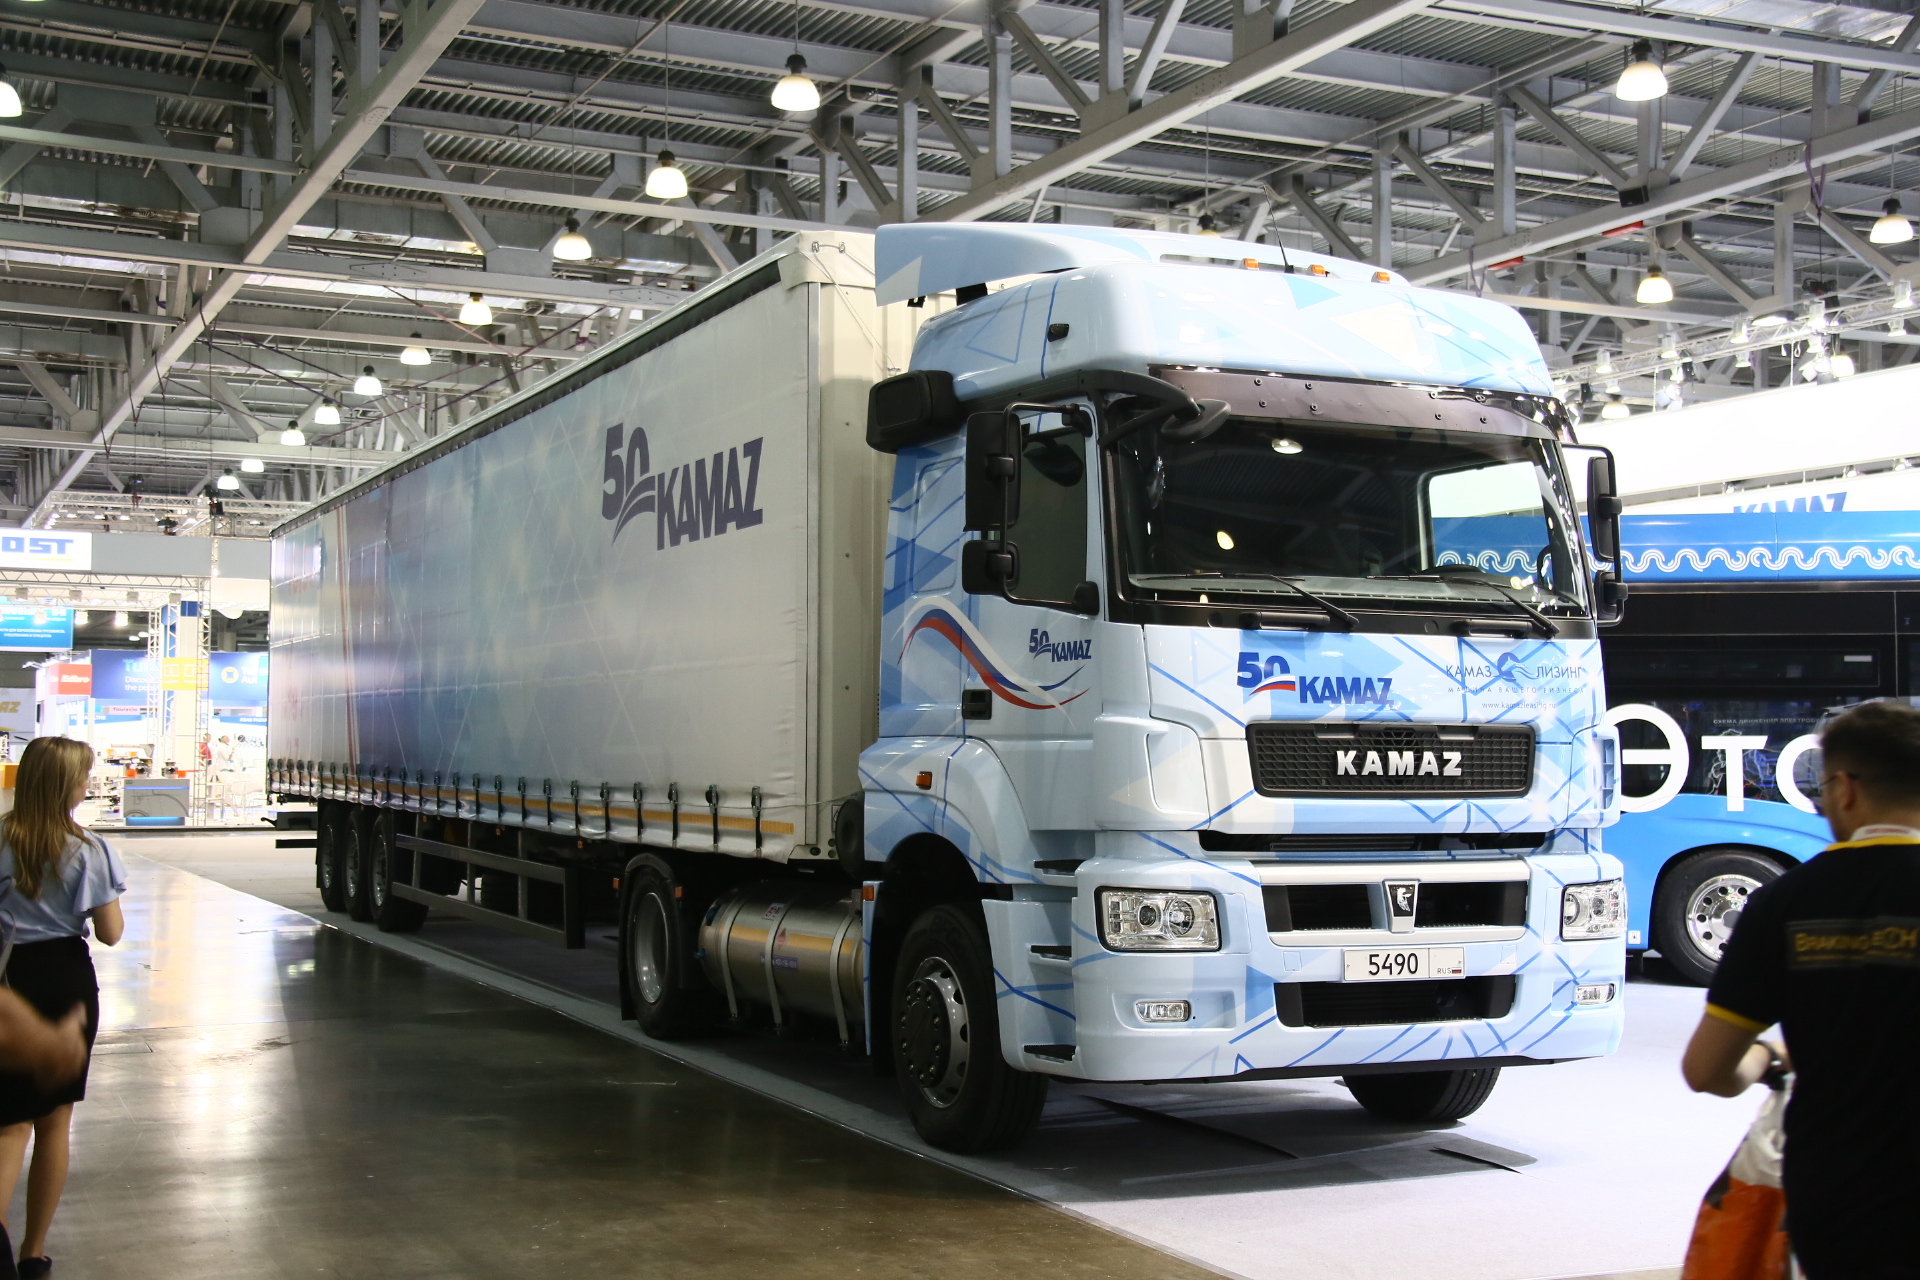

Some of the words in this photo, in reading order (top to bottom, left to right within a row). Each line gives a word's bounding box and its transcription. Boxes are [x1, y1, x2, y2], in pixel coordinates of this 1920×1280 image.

[602, 423, 649, 520] 50
[657, 437, 763, 550] KAMAZ
[1029, 628, 1050, 654] 50
[1052, 639, 1092, 662] KAMAZ
[1237, 652, 1291, 689] 50
[1299, 676, 1395, 705] KAMAZ
[1446, 665, 1492, 678] КАМАЗ
[1536, 666, 1583, 679] ЛИЗИНГ
[1336, 751, 1462, 776] KAMAZ
[1368, 953, 1419, 976] 5490
